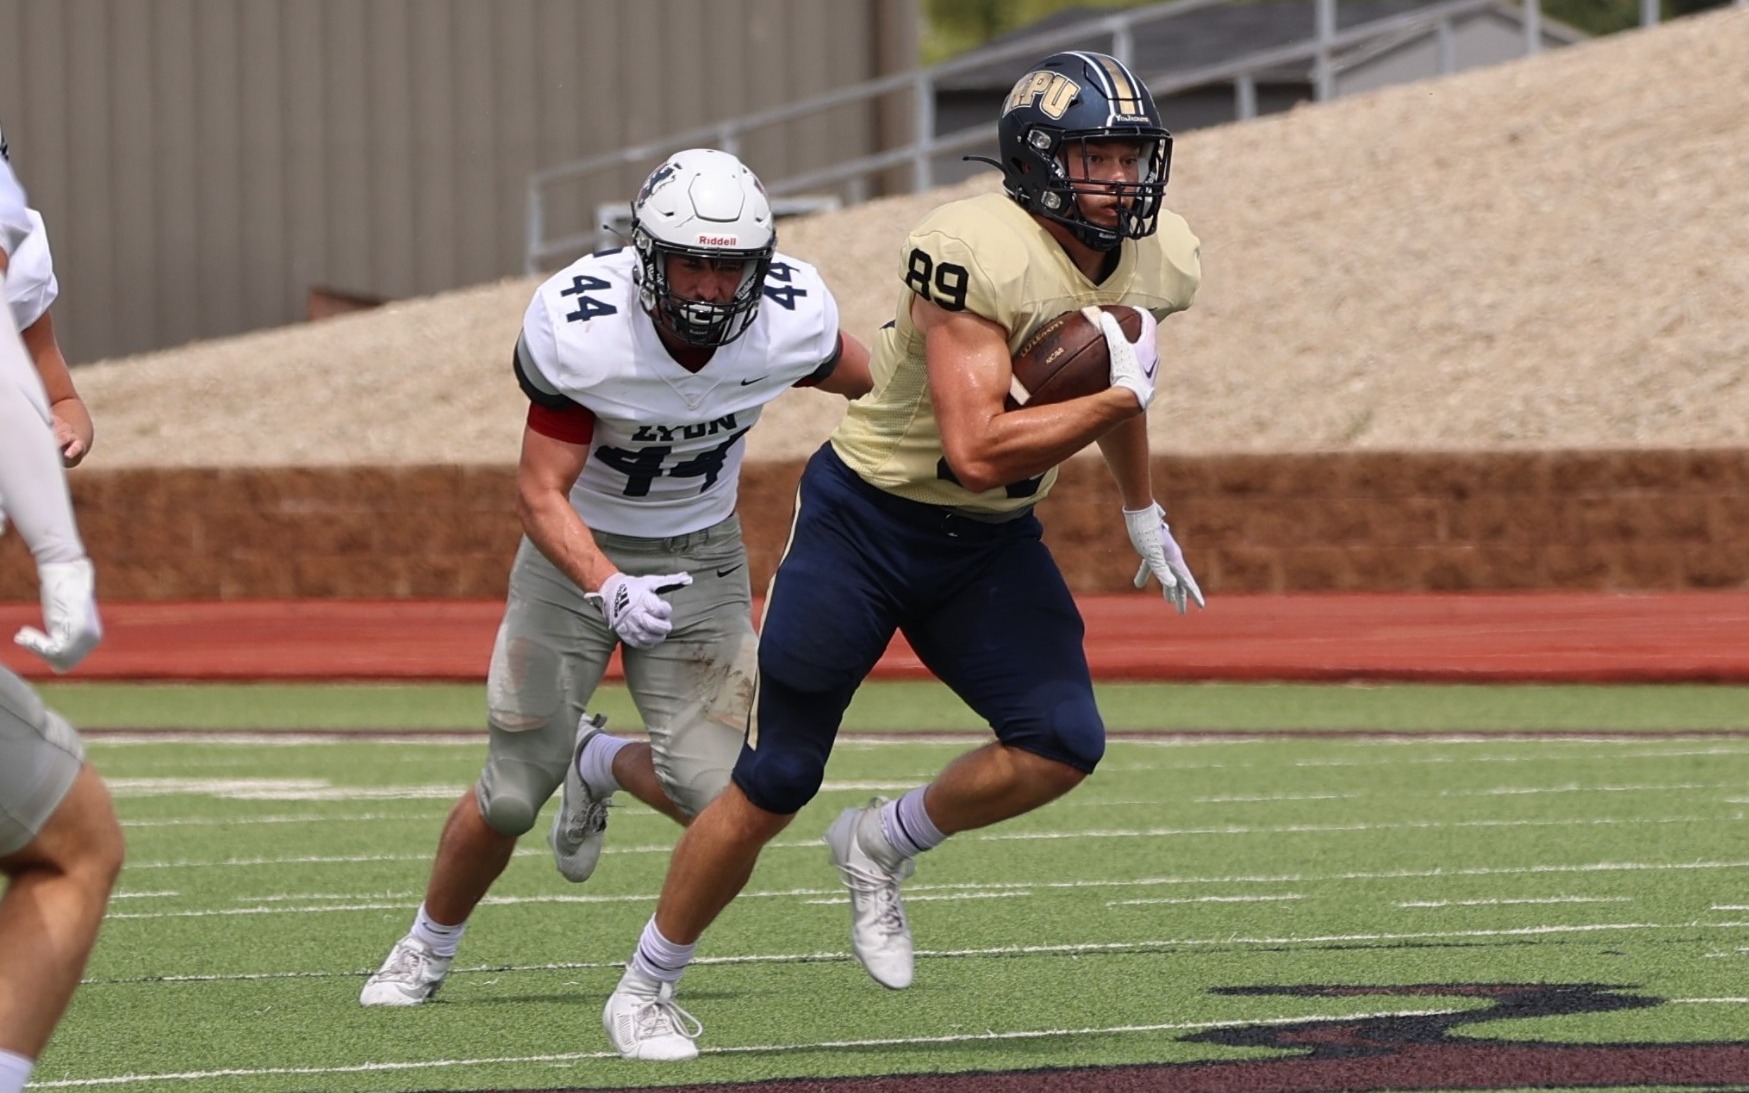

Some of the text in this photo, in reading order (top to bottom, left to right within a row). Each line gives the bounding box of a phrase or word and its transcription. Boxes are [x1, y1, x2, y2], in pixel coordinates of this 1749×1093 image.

[699, 235, 736, 246] Riddell
[560, 275, 618, 323] 44
[763, 262, 807, 310] 44
[905, 248, 969, 312] 89
[631, 413, 738, 442] LYON
[594, 424, 752, 497] 44
